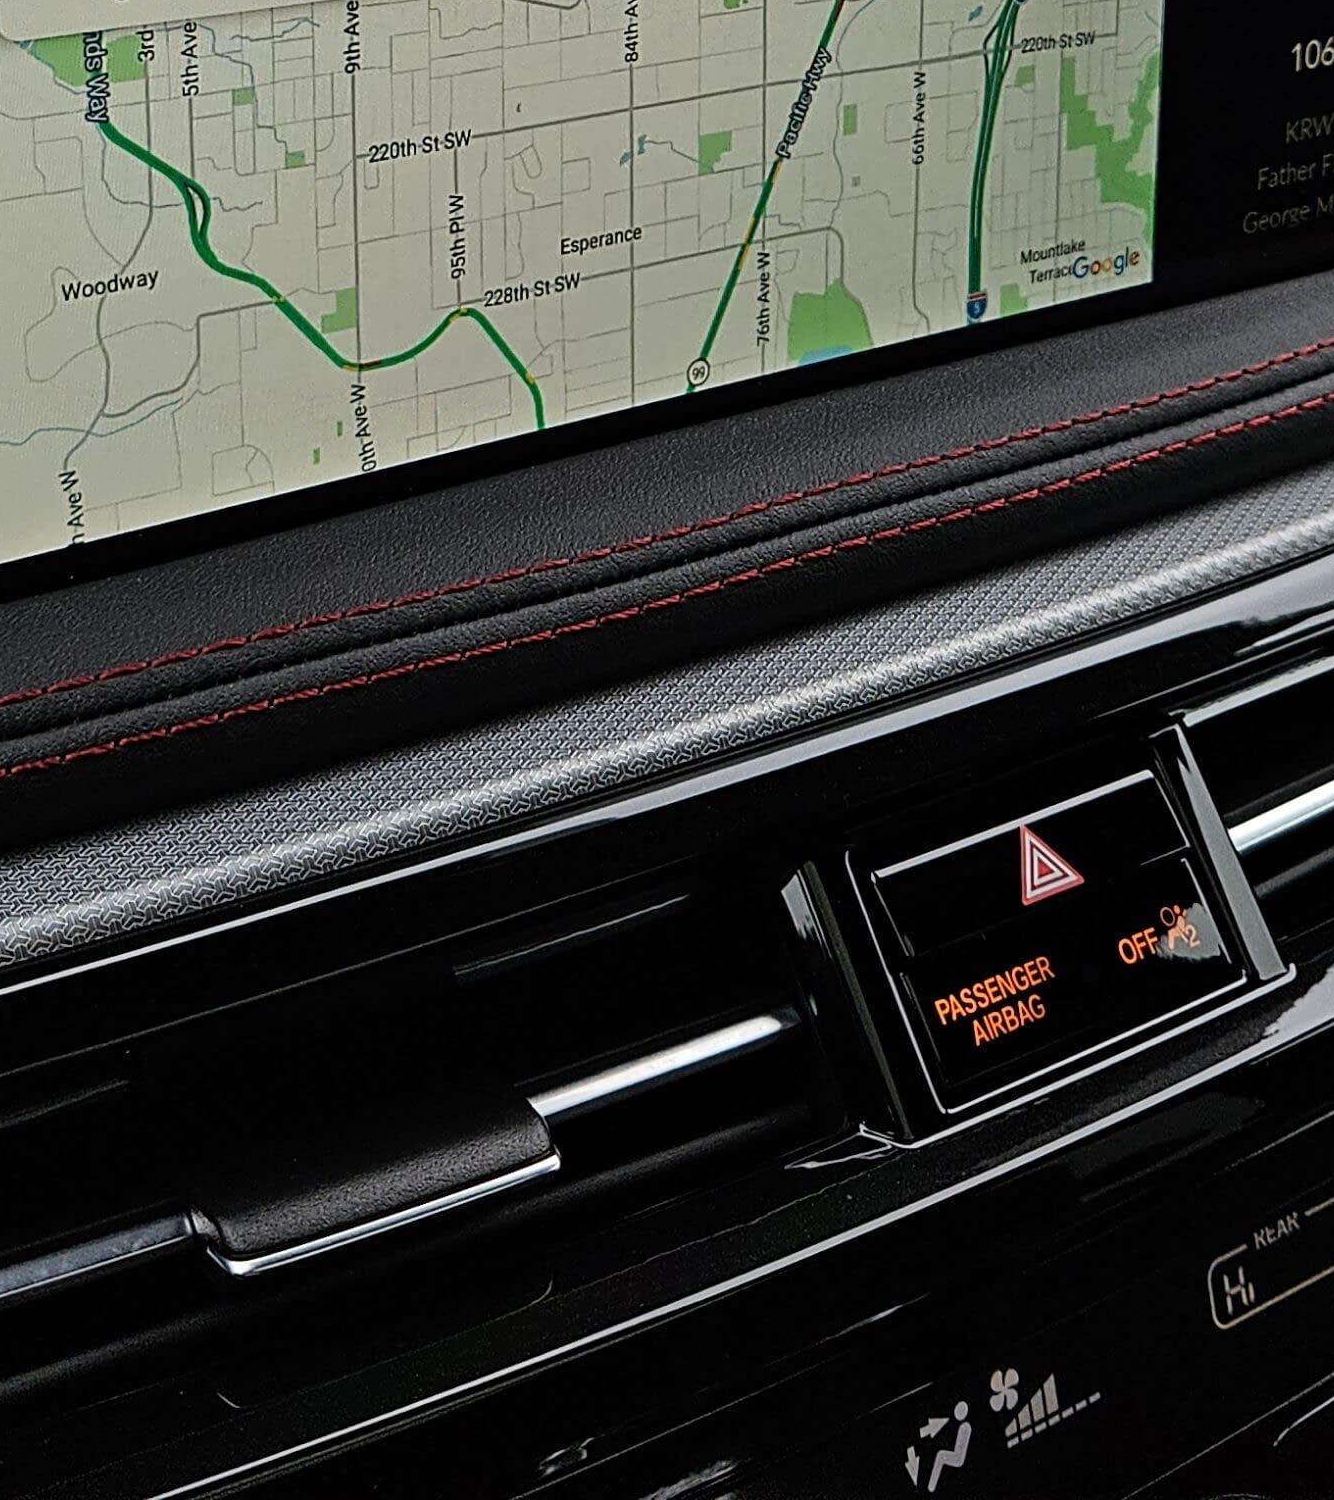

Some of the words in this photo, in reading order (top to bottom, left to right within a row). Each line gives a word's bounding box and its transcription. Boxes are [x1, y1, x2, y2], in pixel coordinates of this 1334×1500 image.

[343, 0, 360, 37] Ave
[136, 29, 155, 62] 3rd
[181, 21, 199, 59] Ave
[624, 23, 639, 63] 84th
[1020, 35, 1056, 54] 220th
[1059, 33, 1072, 49] St
[1075, 31, 1096, 47] SW
[343, 42, 361, 74] 9th
[181, 64, 199, 97] 5th
[913, 72, 926, 89] W
[85, 73, 111, 123] Way
[775, 90, 813, 160] Pacific
[801, 45, 832, 91] Hwy
[913, 92, 926, 123] Ave
[368, 140, 416, 163] 220th
[421, 136, 440, 154] St
[444, 129, 471, 149] SW
[912, 127, 925, 166] 66th
[1257, 160, 1316, 191] Father
[449, 195, 464, 214] W
[1242, 206, 1311, 235] George
[449, 215, 465, 234] Pl
[560, 226, 643, 256] Esperance
[449, 238, 466, 279] 95th
[757, 252, 770, 270] W
[1020, 239, 1086, 265] Mountlake
[1072, 246, 1140, 279] Google
[61, 269, 159, 301] Woodway
[484, 283, 530, 308] 228th
[533, 280, 551, 298] St
[554, 272, 581, 292] SW
[757, 272, 770, 303] Ave
[1029, 267, 1072, 284] Terrac
[756, 307, 770, 347] 76th
[691, 365, 706, 381] 99
[350, 384, 366, 404] W
[355, 405, 371, 438] Ave
[58, 470, 79, 492] W
[67, 492, 85, 527] Ave
[1118, 927, 1160, 965] OFF
[934, 956, 1055, 1025] PASSENGER
[972, 994, 1046, 1046] AIRBAG
